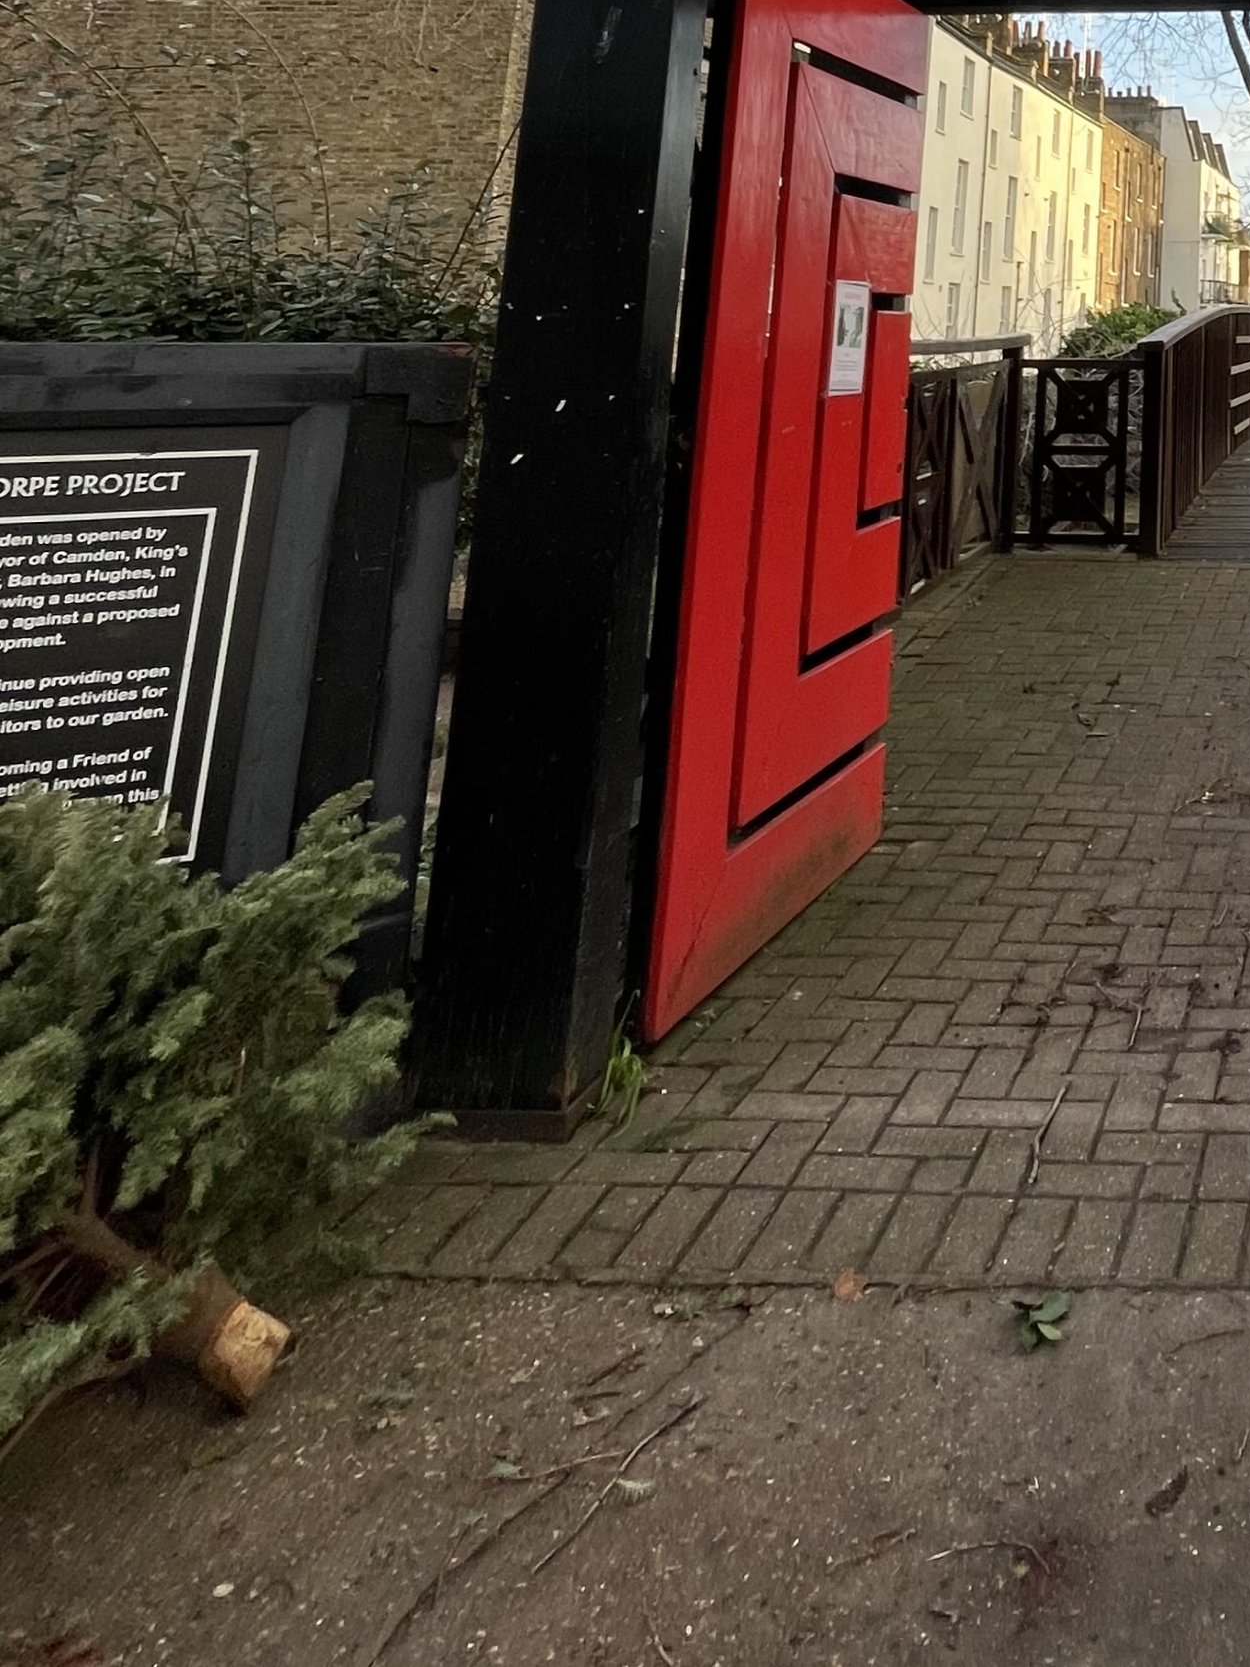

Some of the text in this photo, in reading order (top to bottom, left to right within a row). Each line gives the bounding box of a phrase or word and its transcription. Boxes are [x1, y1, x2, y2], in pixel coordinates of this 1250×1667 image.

[66, 472, 186, 497] PROJECT
[37, 533, 73, 544] was
[76, 527, 143, 545] opened
[146, 527, 167, 541] by
[28, 552, 50, 565] of
[52, 549, 131, 564] Camden,
[135, 545, 189, 561] King's
[7, 573, 82, 587] Barbara
[85, 568, 156, 583] Hughes,
[160, 565, 176, 578] in
[48, 594, 60, 605] a
[63, 585, 159, 604] successful
[12, 611, 79, 630] against
[82, 612, 94, 623] a
[96, 603, 180, 624] proposed
[39, 670, 122, 691] providing
[127, 666, 170, 681] open
[58, 689, 138, 707] activities
[142, 686, 168, 699] for
[47, 716, 64, 729] to
[68, 713, 99, 727] our
[103, 706, 168, 726] garden.
[57, 758, 68, 769] a
[73, 748, 131, 768] Friend
[133, 746, 152, 760] of
[53, 771, 127, 791] involved
[130, 769, 147, 782] in
[128, 787, 160, 803] this
